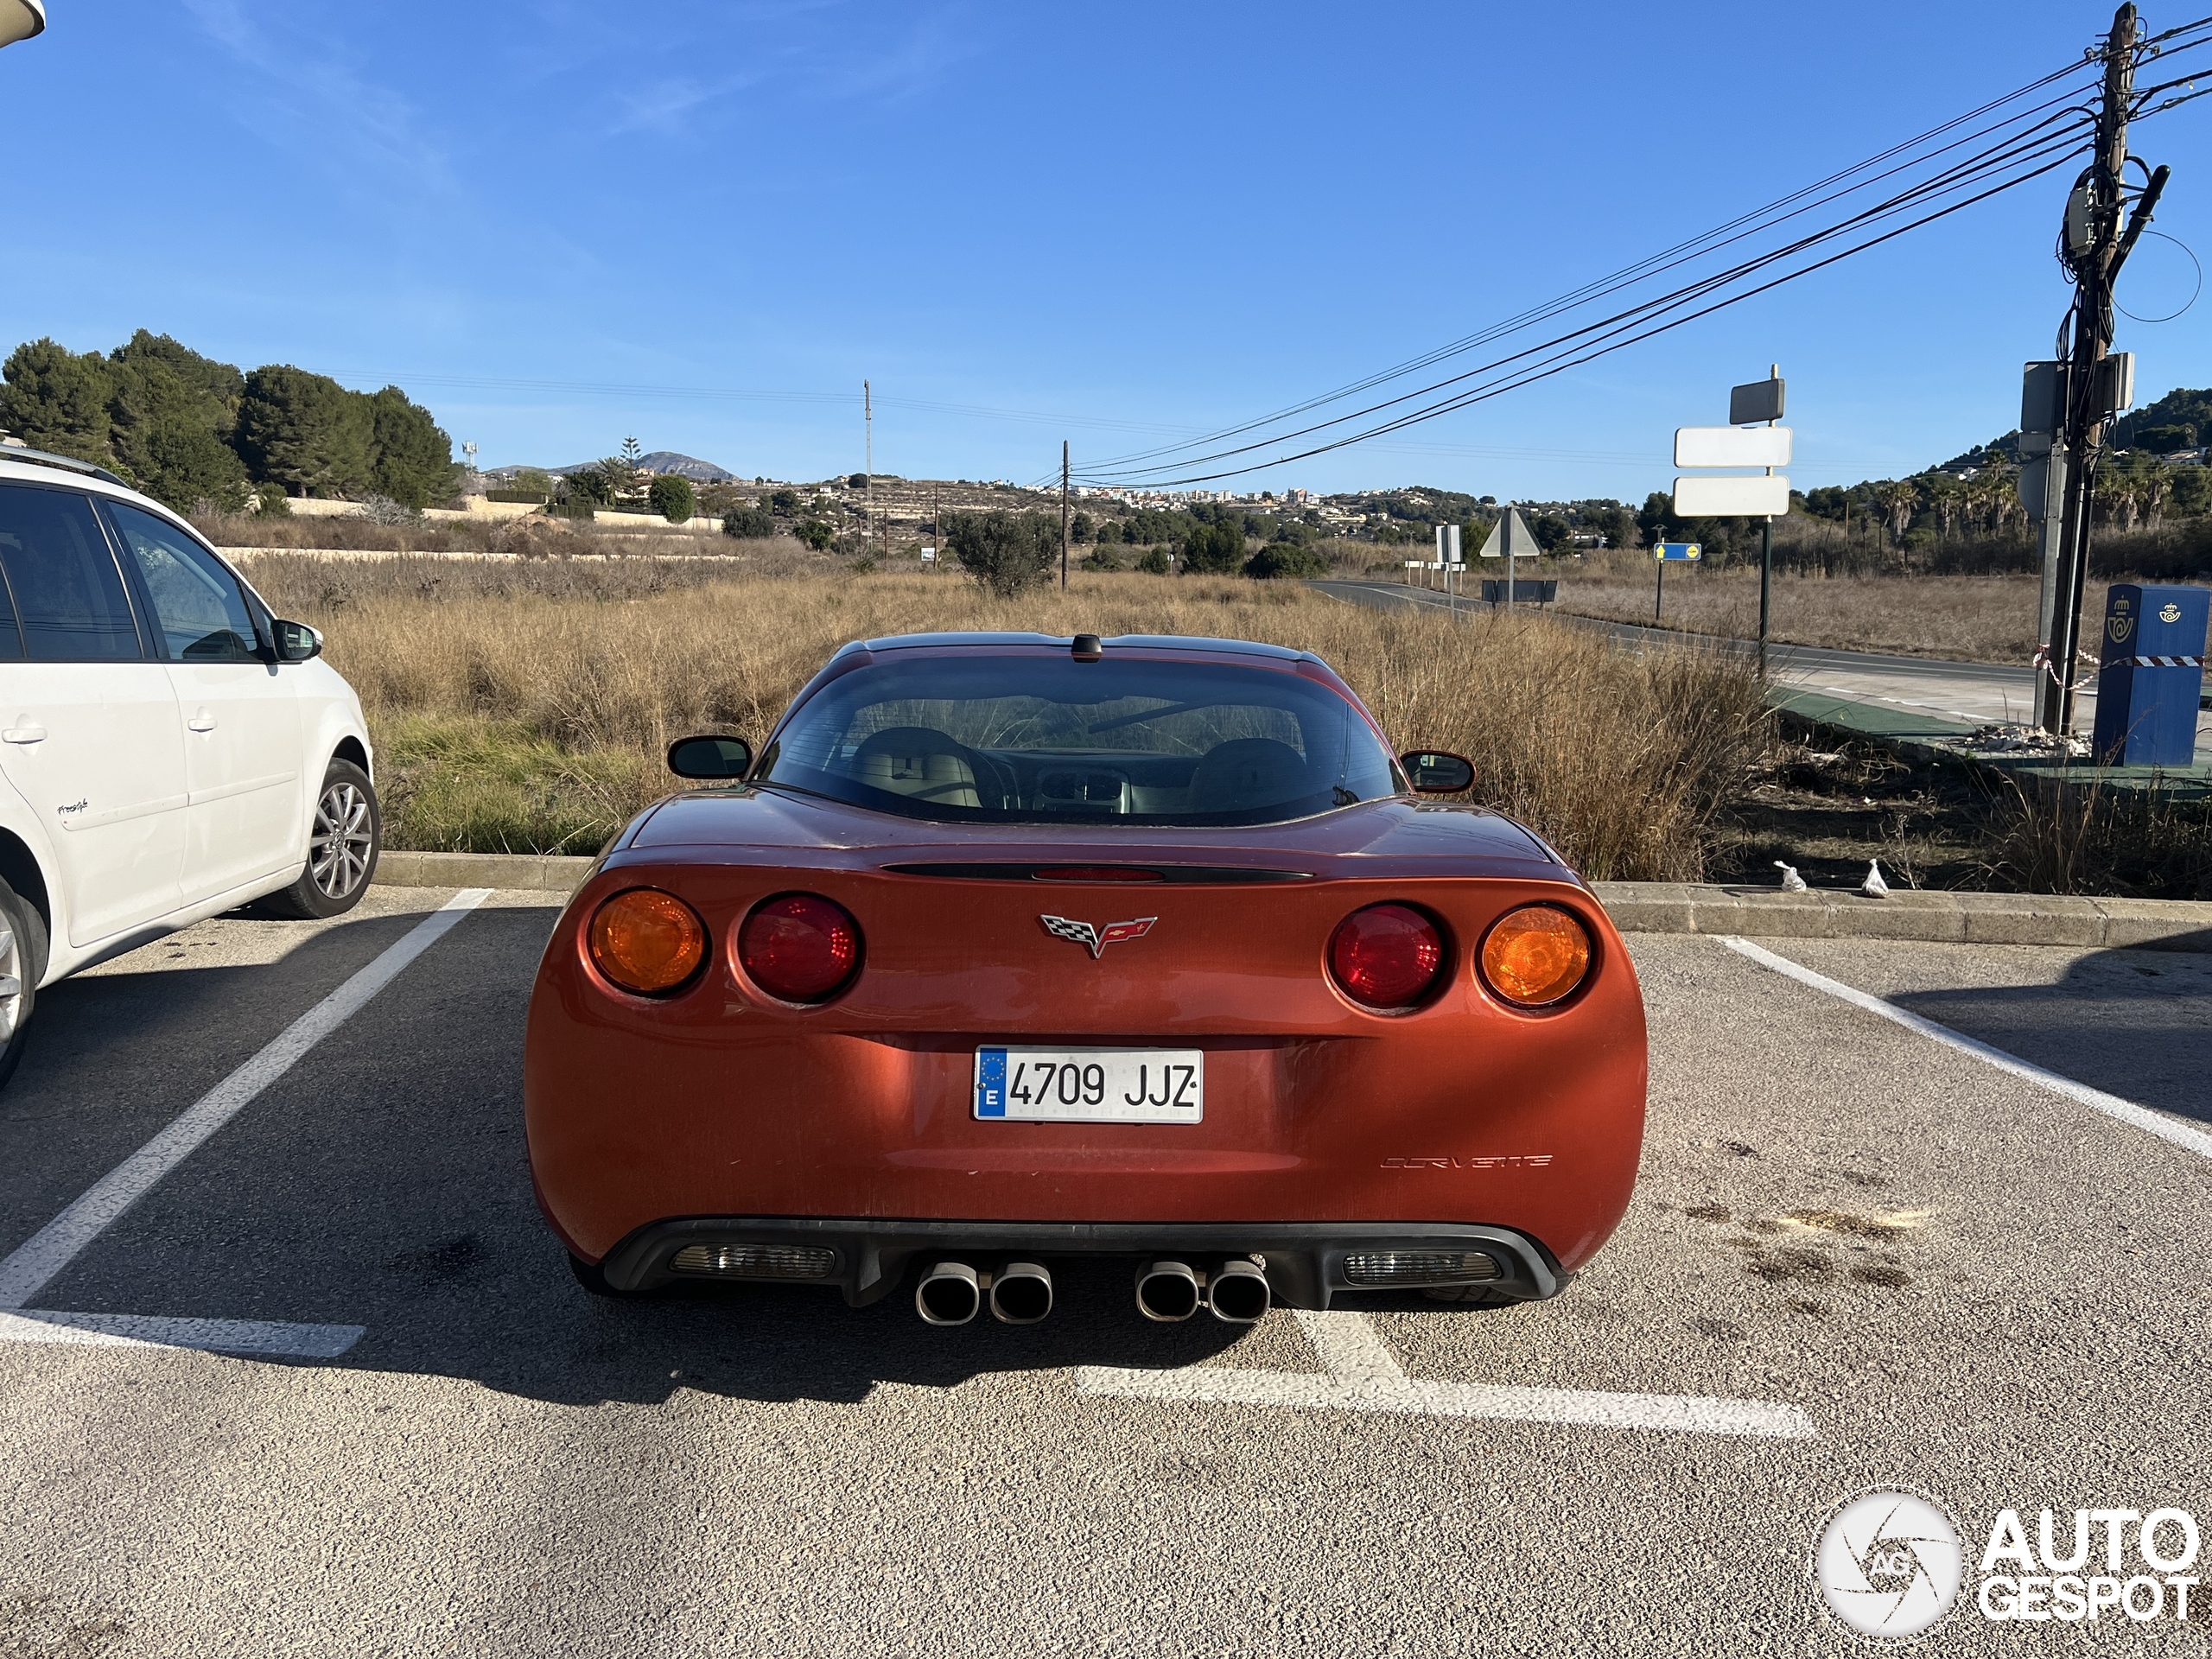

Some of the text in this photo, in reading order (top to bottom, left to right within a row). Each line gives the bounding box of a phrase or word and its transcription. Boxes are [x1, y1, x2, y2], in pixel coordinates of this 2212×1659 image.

[1009, 1063, 1196, 1108] 4709 JJZ
[985, 1090, 998, 1105] E
[1380, 1154, 1554, 1168] CORVETTE
